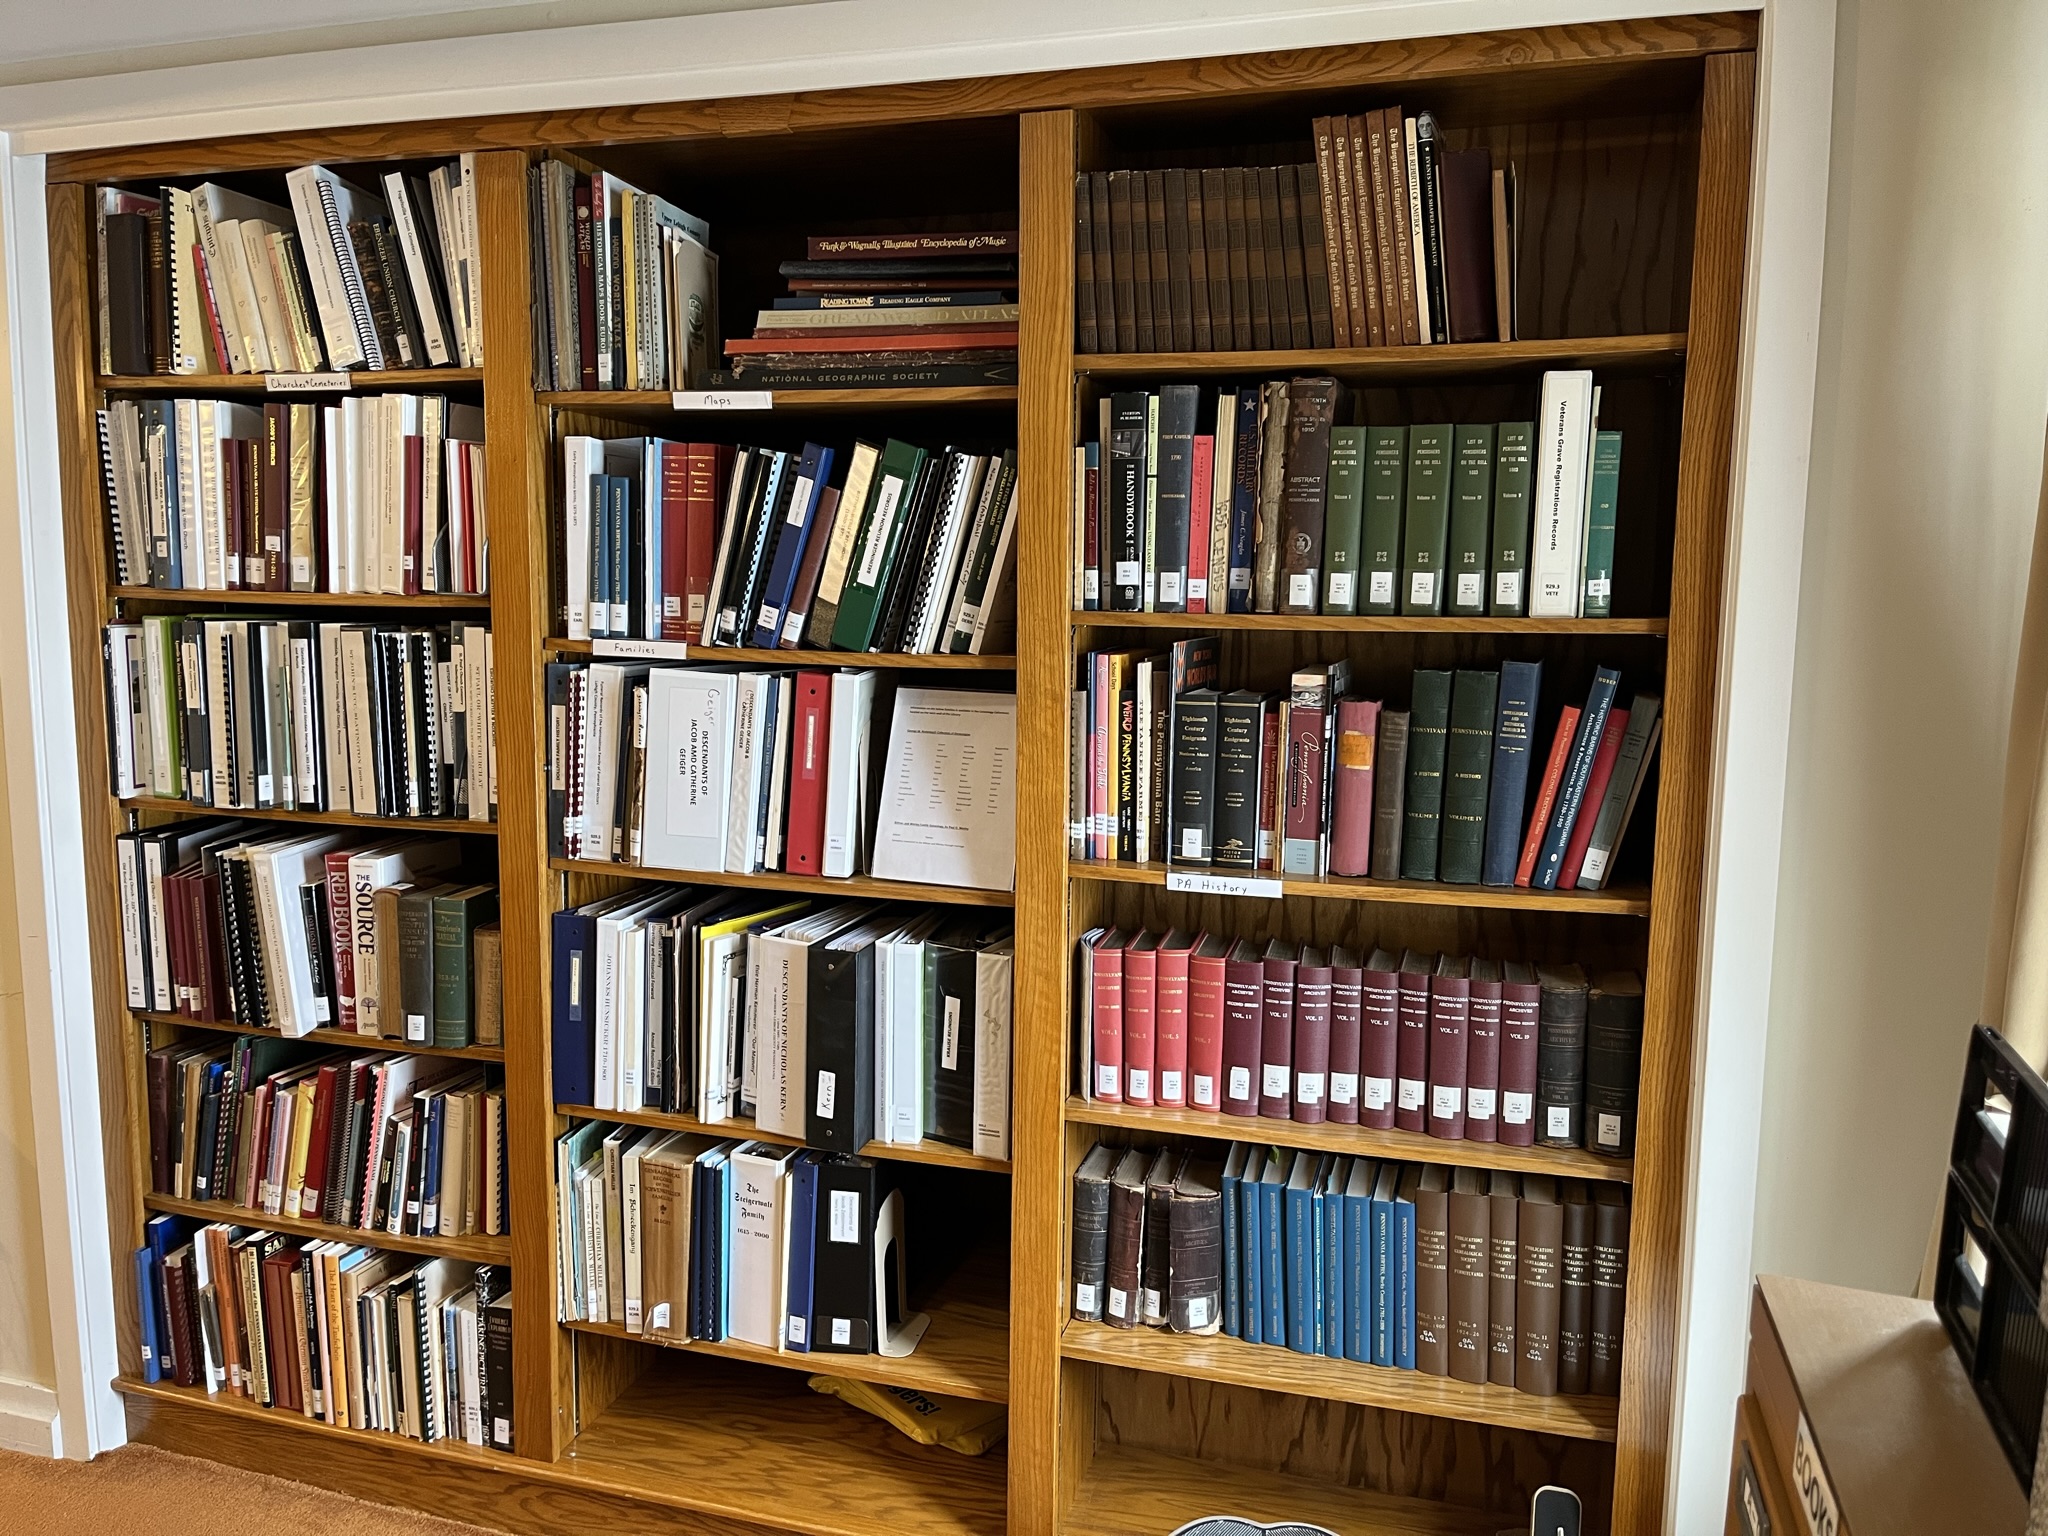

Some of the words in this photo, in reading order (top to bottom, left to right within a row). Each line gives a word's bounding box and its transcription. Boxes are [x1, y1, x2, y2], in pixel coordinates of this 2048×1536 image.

[1408, 142, 1416, 157] THE
[1320, 150, 1331, 194] Biographical
[1373, 147, 1383, 193] Biographical
[1391, 142, 1402, 187] Biographical
[1409, 158, 1418, 191] REBIRTH
[1412, 191, 1419, 200] OF
[1324, 195, 1335, 239] Encyclopedia
[1376, 193, 1388, 238] Encyclopedia
[1395, 188, 1405, 233] Encyclopedia
[1413, 201, 1421, 236] AMERICA
[596, 222, 604, 272] HISTORICAL
[819, 240, 840, 251] Funk
[847, 241, 880, 250] Wagnalls
[920, 238, 968, 249] Encyclopedia
[968, 237, 979, 248] of
[977, 236, 1007, 246] Music
[373, 223, 387, 262] EBENEZER
[382, 262, 394, 288] UNION
[388, 287, 401, 323] CHURCH
[1331, 262, 1340, 283] United
[1383, 261, 1392, 283] United
[1400, 255, 1409, 277] United
[1402, 278, 1410, 300] States
[820, 296, 849, 308] READING
[849, 296, 874, 307] TOWNE
[270, 378, 306, 389] Churches
[309, 377, 347, 388] Cemeteries
[762, 374, 812, 383] NATIONAL
[817, 373, 886, 382] GEOGRAPHIC
[892, 372, 939, 380] SOCIETY
[704, 395, 731, 407] Maps
[1558, 400, 1567, 437] Veterans
[1237, 434, 1248, 485] RECORDS
[1556, 439, 1564, 462] Grave
[1126, 470, 1135, 537] HANDYBOOK
[1553, 465, 1563, 517] Registrations
[883, 493, 893, 519] RECORDS
[1550, 518, 1559, 551] Records
[1212, 538, 1226, 592] CENSUS
[613, 642, 656, 655] Families
[704, 688, 720, 726] Geiger
[1600, 697, 1609, 708] THE
[1122, 700, 1134, 732] WEIRD
[1157, 710, 1166, 729] The
[1593, 709, 1605, 736] HISTORIC
[1451, 728, 1493, 736] PENNSYLVANIA
[1587, 736, 1597, 755] BARNS
[1121, 733, 1133, 802] PENNSYLVANIA
[1153, 730, 1165, 798] Pennsylvania
[1585, 755, 1591, 764] OF
[1292, 731, 1321, 823] Pennsylvania
[1571, 764, 1588, 807] SOUTHEASTERN
[701, 785, 708, 796] OF
[1154, 801, 1163, 825] Barn
[1558, 808, 1576, 847] PENNSYLVANIA
[331, 871, 348, 905] RED
[1176, 879, 1192, 889] PA
[1201, 879, 1249, 895] History
[334, 906, 353, 953] BOOK
[355, 881, 375, 955] SOURCE
[781, 959, 789, 1024] DESCENDANTS
[781, 1024, 788, 1038] OF
[780, 1039, 788, 1085] NICHOLAS
[779, 1086, 787, 1111] KERN
[821, 1085, 832, 1111] Kern
[629, 1184, 636, 1194] Im
[746, 1182, 759, 1194] The
[629, 1198, 637, 1254] Schneckengang
[741, 1207, 765, 1221] Family
[1454, 1235, 1483, 1243] PUBLICATIONS
[1524, 1245, 1554, 1254] PUBLICATIONS
[1454, 1249, 1483, 1257] GENEALOGICAL
[1524, 1259, 1554, 1268] GENEALOGICAL
[329, 1283, 337, 1303] Heart
[331, 1304, 338, 1312] of
[255, 1310, 263, 1356] PENNSYLVANIA
[1526, 1332, 1540, 1340] VOL.
